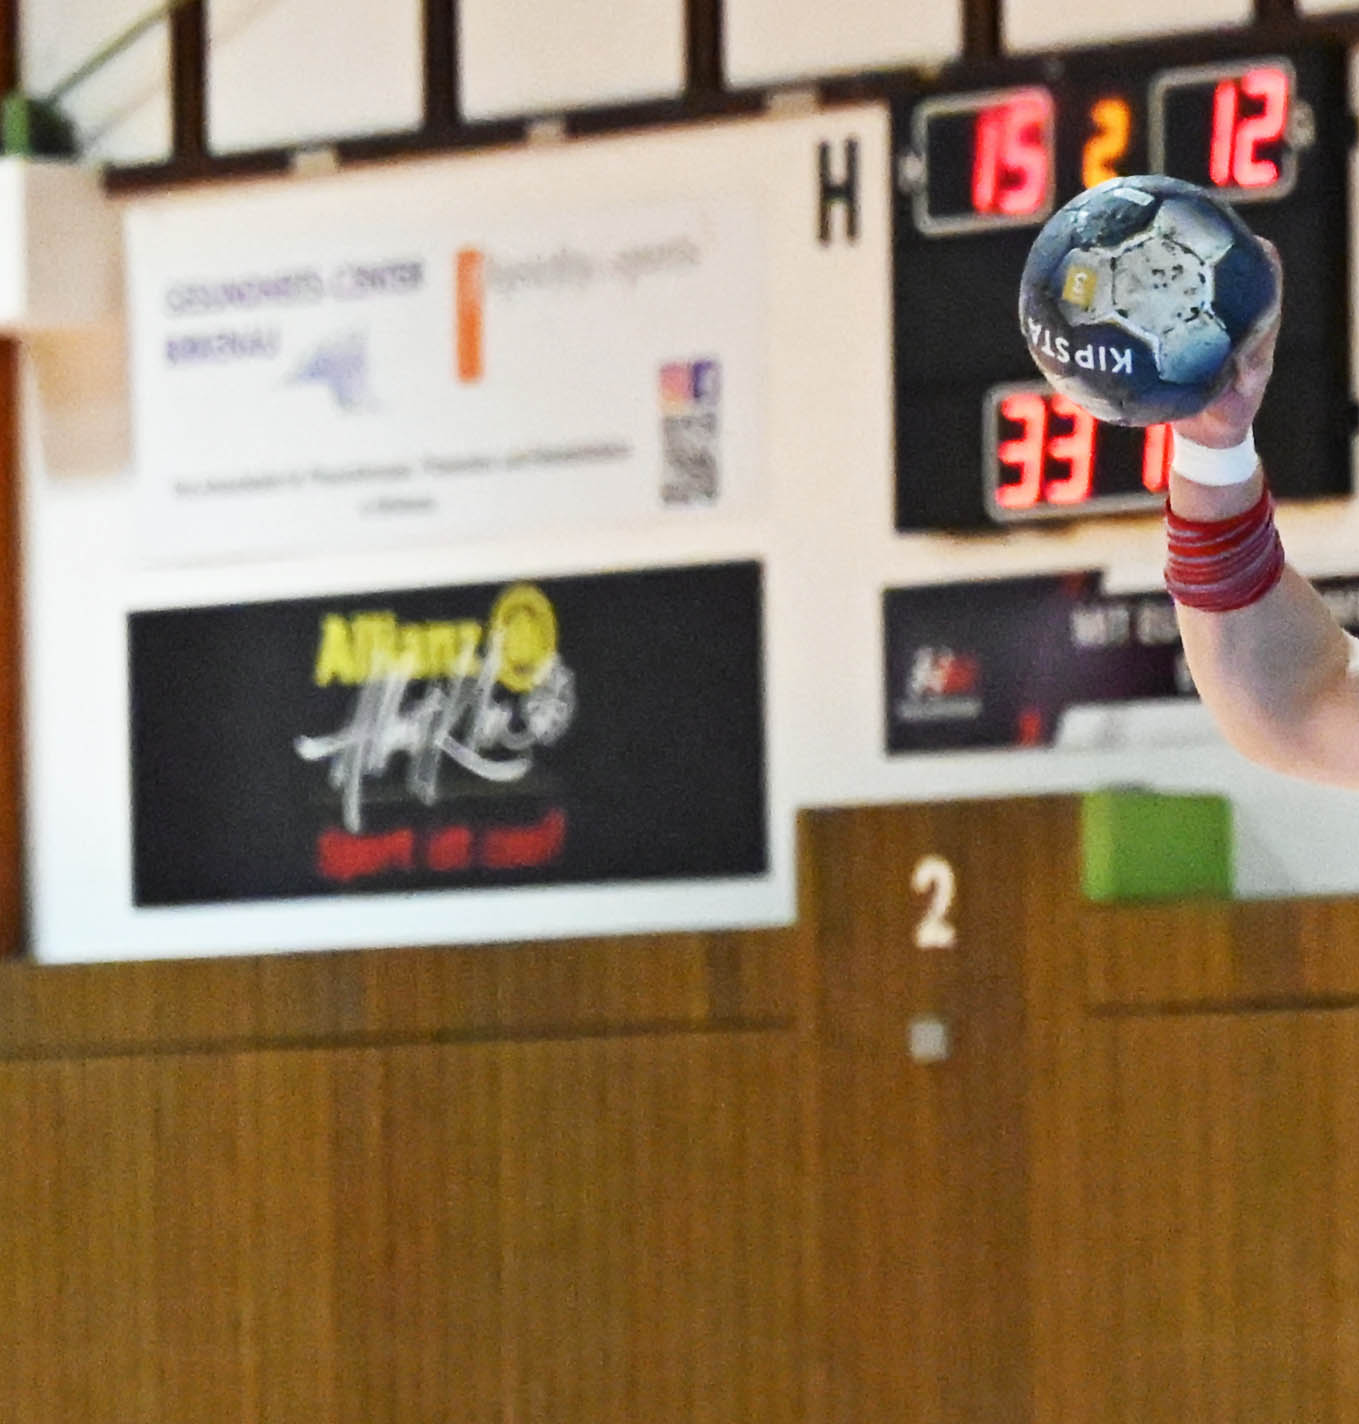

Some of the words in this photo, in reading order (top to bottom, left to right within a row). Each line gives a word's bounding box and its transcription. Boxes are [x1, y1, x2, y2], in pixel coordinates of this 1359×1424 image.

[971, 87, 1053, 215] 15
[1082, 98, 1131, 188] 2
[1210, 66, 1290, 189] 12
[817, 136, 859, 247] H
[1027, 317, 1133, 375] KIPSTA
[995, 392, 1098, 509] 33
[911, 854, 958, 950] 2
